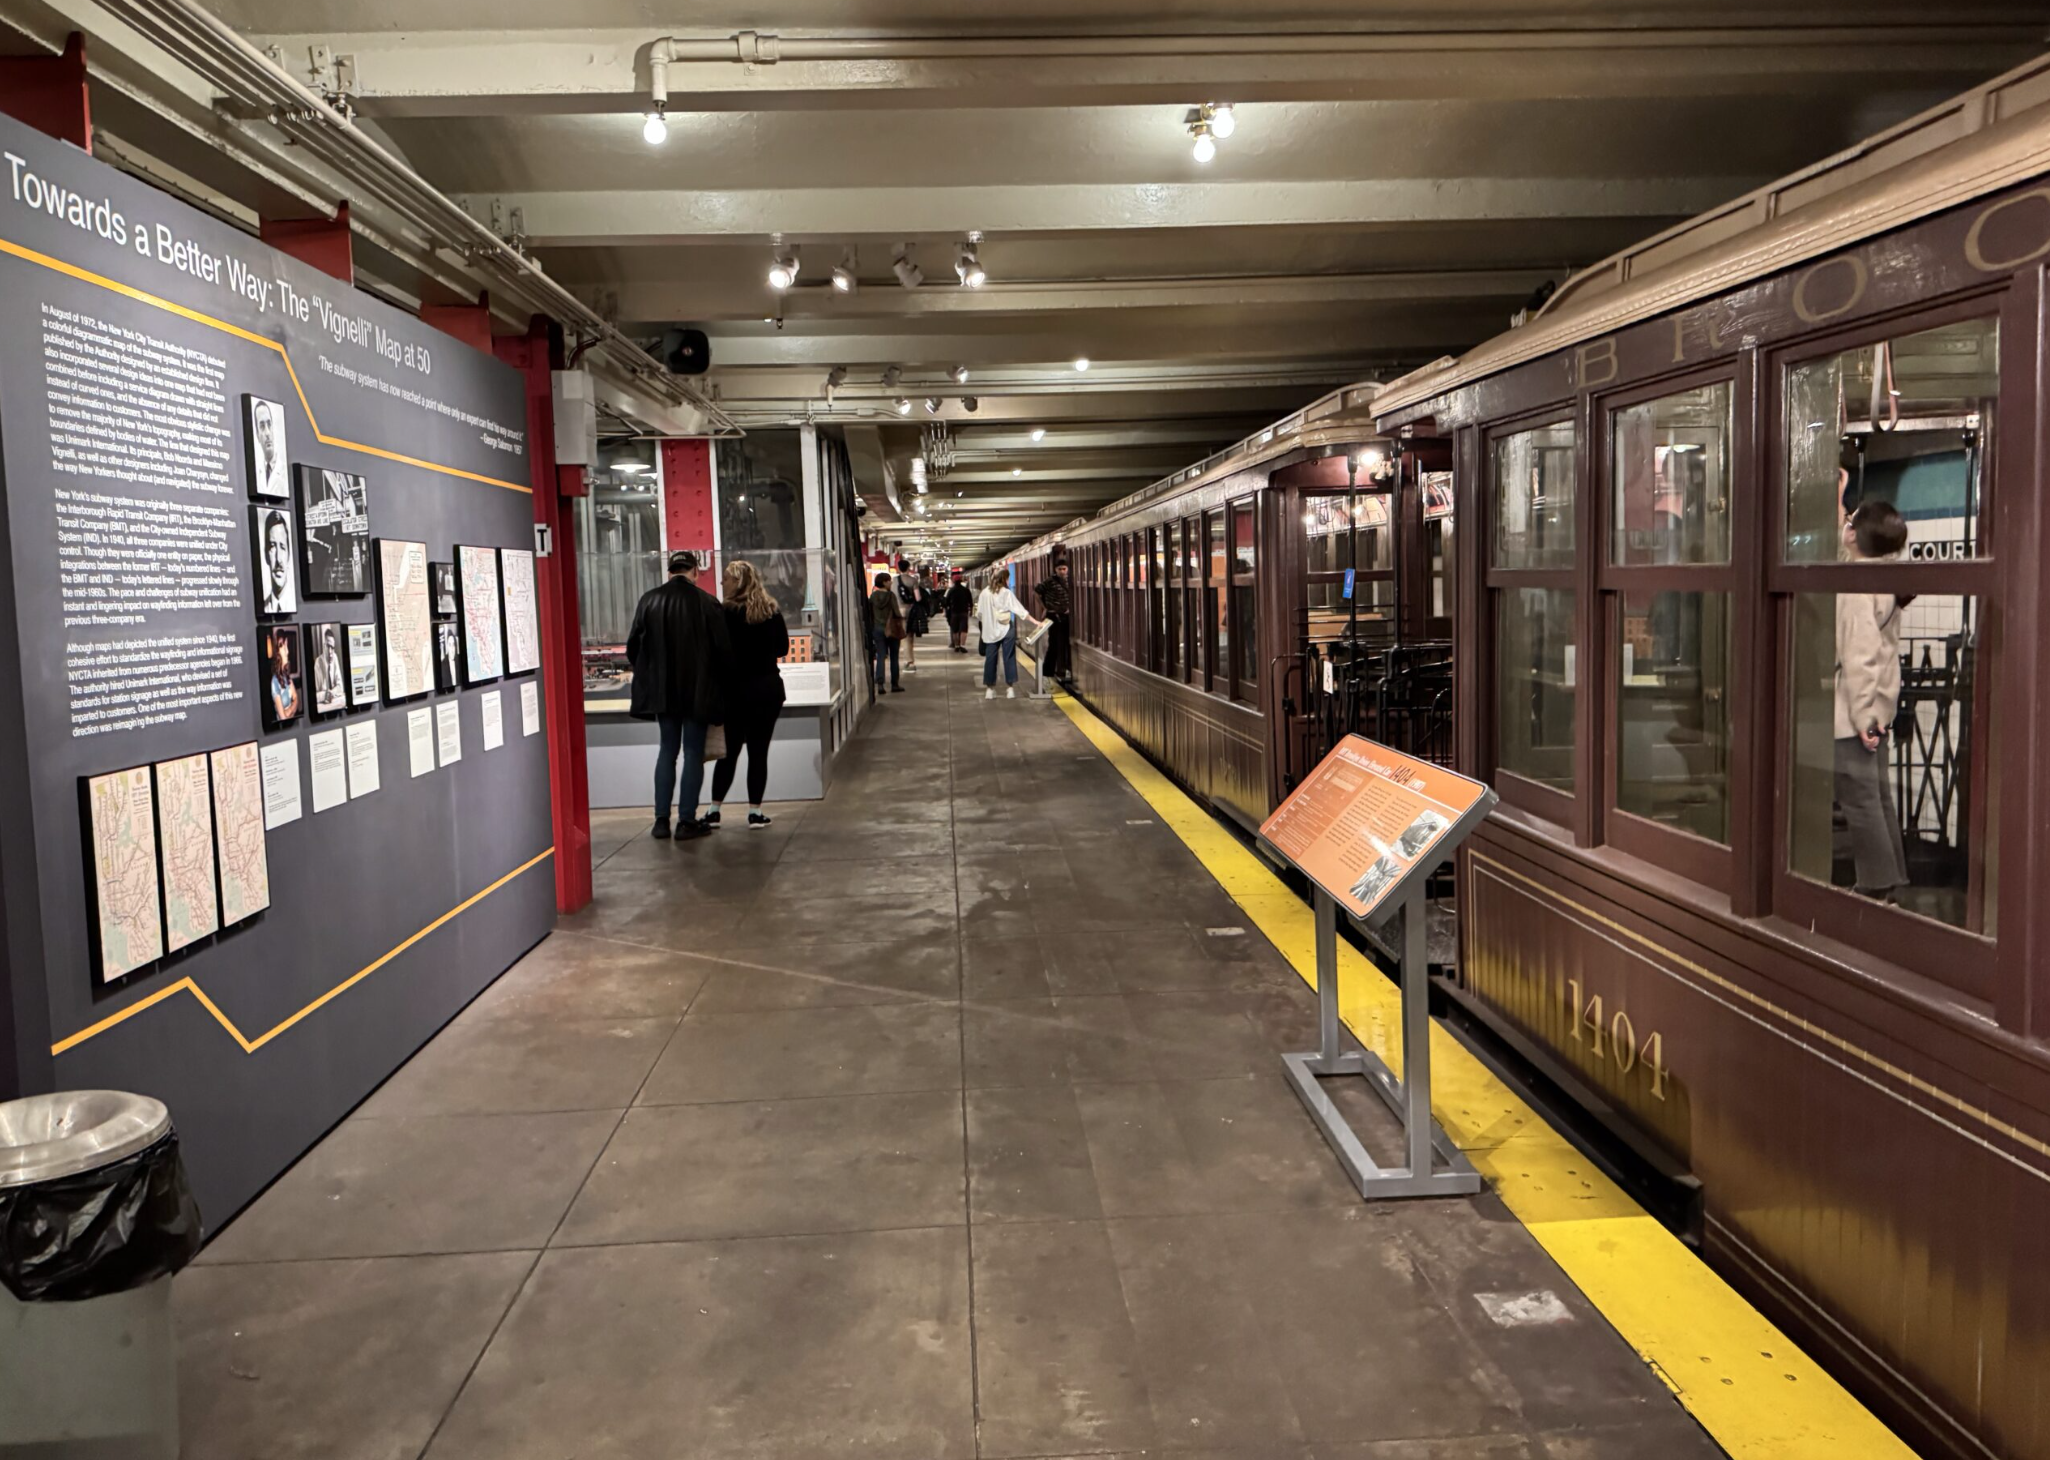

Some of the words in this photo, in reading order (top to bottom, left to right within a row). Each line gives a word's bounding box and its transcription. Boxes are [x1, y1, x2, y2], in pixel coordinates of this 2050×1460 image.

[4, 151, 127, 245] Towards
[134, 224, 151, 257] a
[156, 222, 221, 285] Better
[226, 254, 273, 312] Way:
[276, 279, 309, 322] The
[312, 295, 372, 343] “Vignelli”
[375, 326, 401, 368] Map
[404, 343, 415, 369] at
[417, 346, 431, 375] 50
[41, 302, 48, 313] In
[49, 305, 72, 321] August
[42, 318, 48, 327] a
[48, 320, 72, 334] colorful
[43, 333, 74, 349] published
[44, 346, 59, 358] also
[45, 362, 77, 376] combined
[46, 374, 70, 389] instead
[333, 363, 357, 385] subway
[357, 373, 378, 390] system
[379, 378, 389, 394] has
[389, 385, 401, 398] now
[401, 389, 421, 405] reached
[421, 396, 425, 407] a
[425, 398, 437, 410] point
[437, 402, 451, 416] where
[47, 390, 71, 404] convey
[48, 403, 56, 413] to
[56, 406, 80, 418] remove
[49, 417, 85, 433] boundaries
[50, 433, 65, 443] was
[51, 445, 77, 460] Vignelli,
[52, 460, 64, 470] the
[64, 463, 78, 474] way
[54, 488, 70, 499] New
[55, 503, 67, 513] the
[56, 516, 79, 528] Transit
[58, 530, 82, 543] System
[536, 529, 547, 552] T
[58, 546, 83, 555] control.
[60, 559, 96, 571] integrations
[60, 573, 72, 583] the
[72, 573, 87, 583] BMT
[62, 587, 73, 597] the
[63, 601, 85, 611] instant
[64, 615, 91, 628] previous
[66, 642, 94, 654] Although
[67, 656, 95, 667] cohesive
[68, 669, 92, 681] NYCTA
[68, 685, 82, 695] The
[70, 696, 101, 709] standards
[71, 710, 99, 724] imparted
[72, 724, 99, 737] direction
[1389, 765, 1416, 786] 1404
[1569, 979, 1669, 1101] 1404
